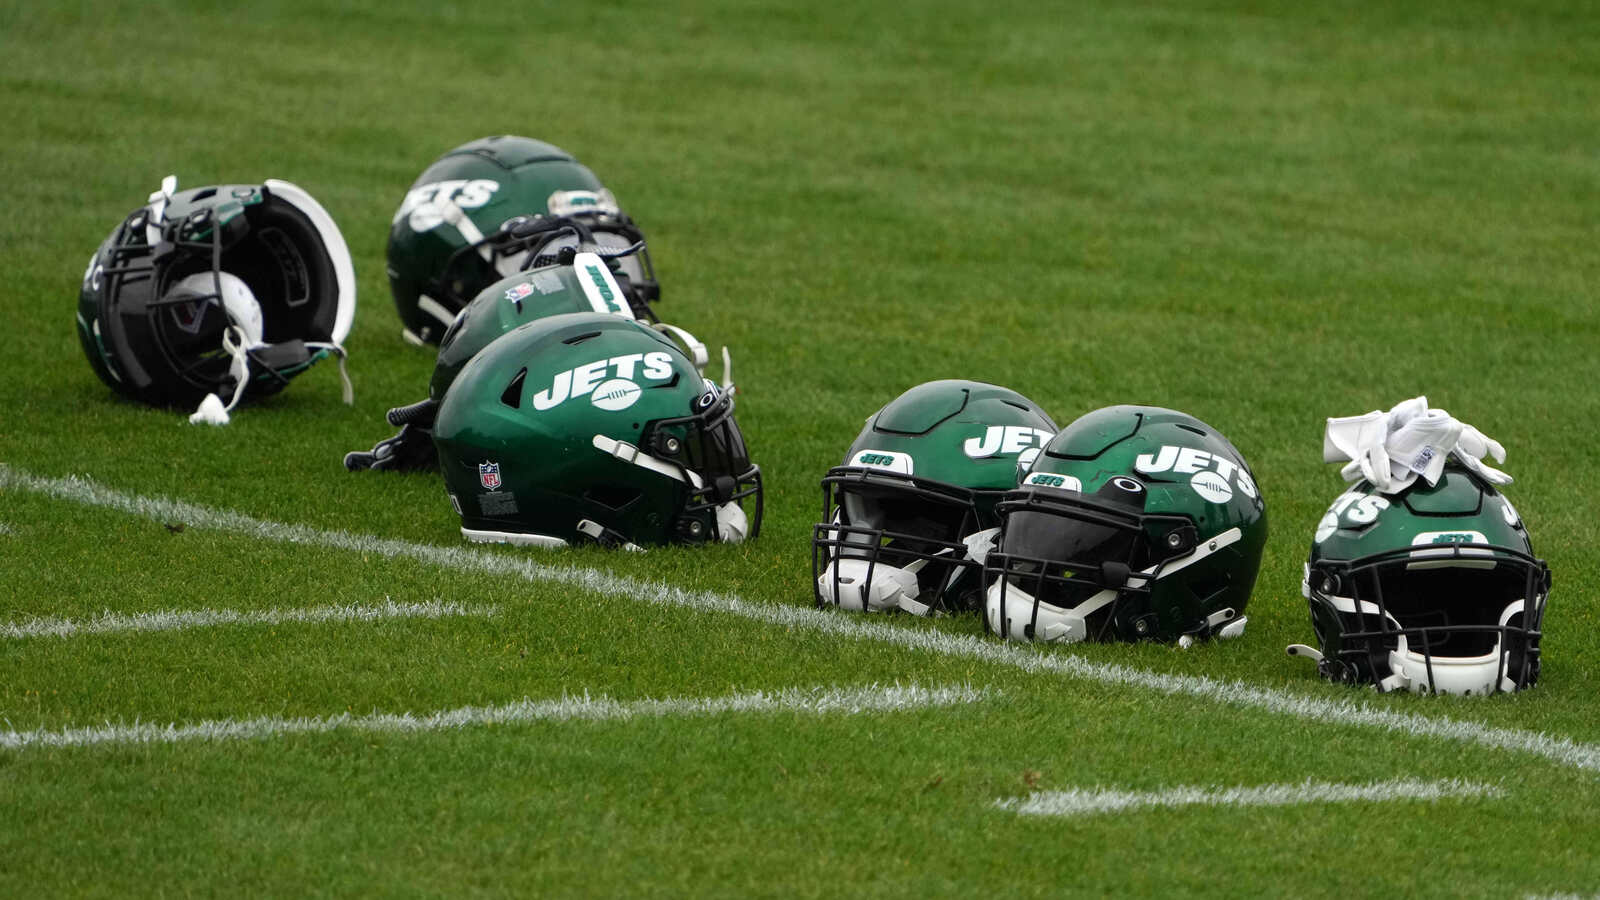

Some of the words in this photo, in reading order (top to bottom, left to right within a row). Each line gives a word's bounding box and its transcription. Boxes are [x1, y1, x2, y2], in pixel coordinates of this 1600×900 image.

[533, 351, 673, 411] JETS
[965, 426, 1055, 457] JET
[859, 453, 895, 466] JETS
[1136, 445, 1257, 499] JETS
[1031, 474, 1065, 487] JETS
